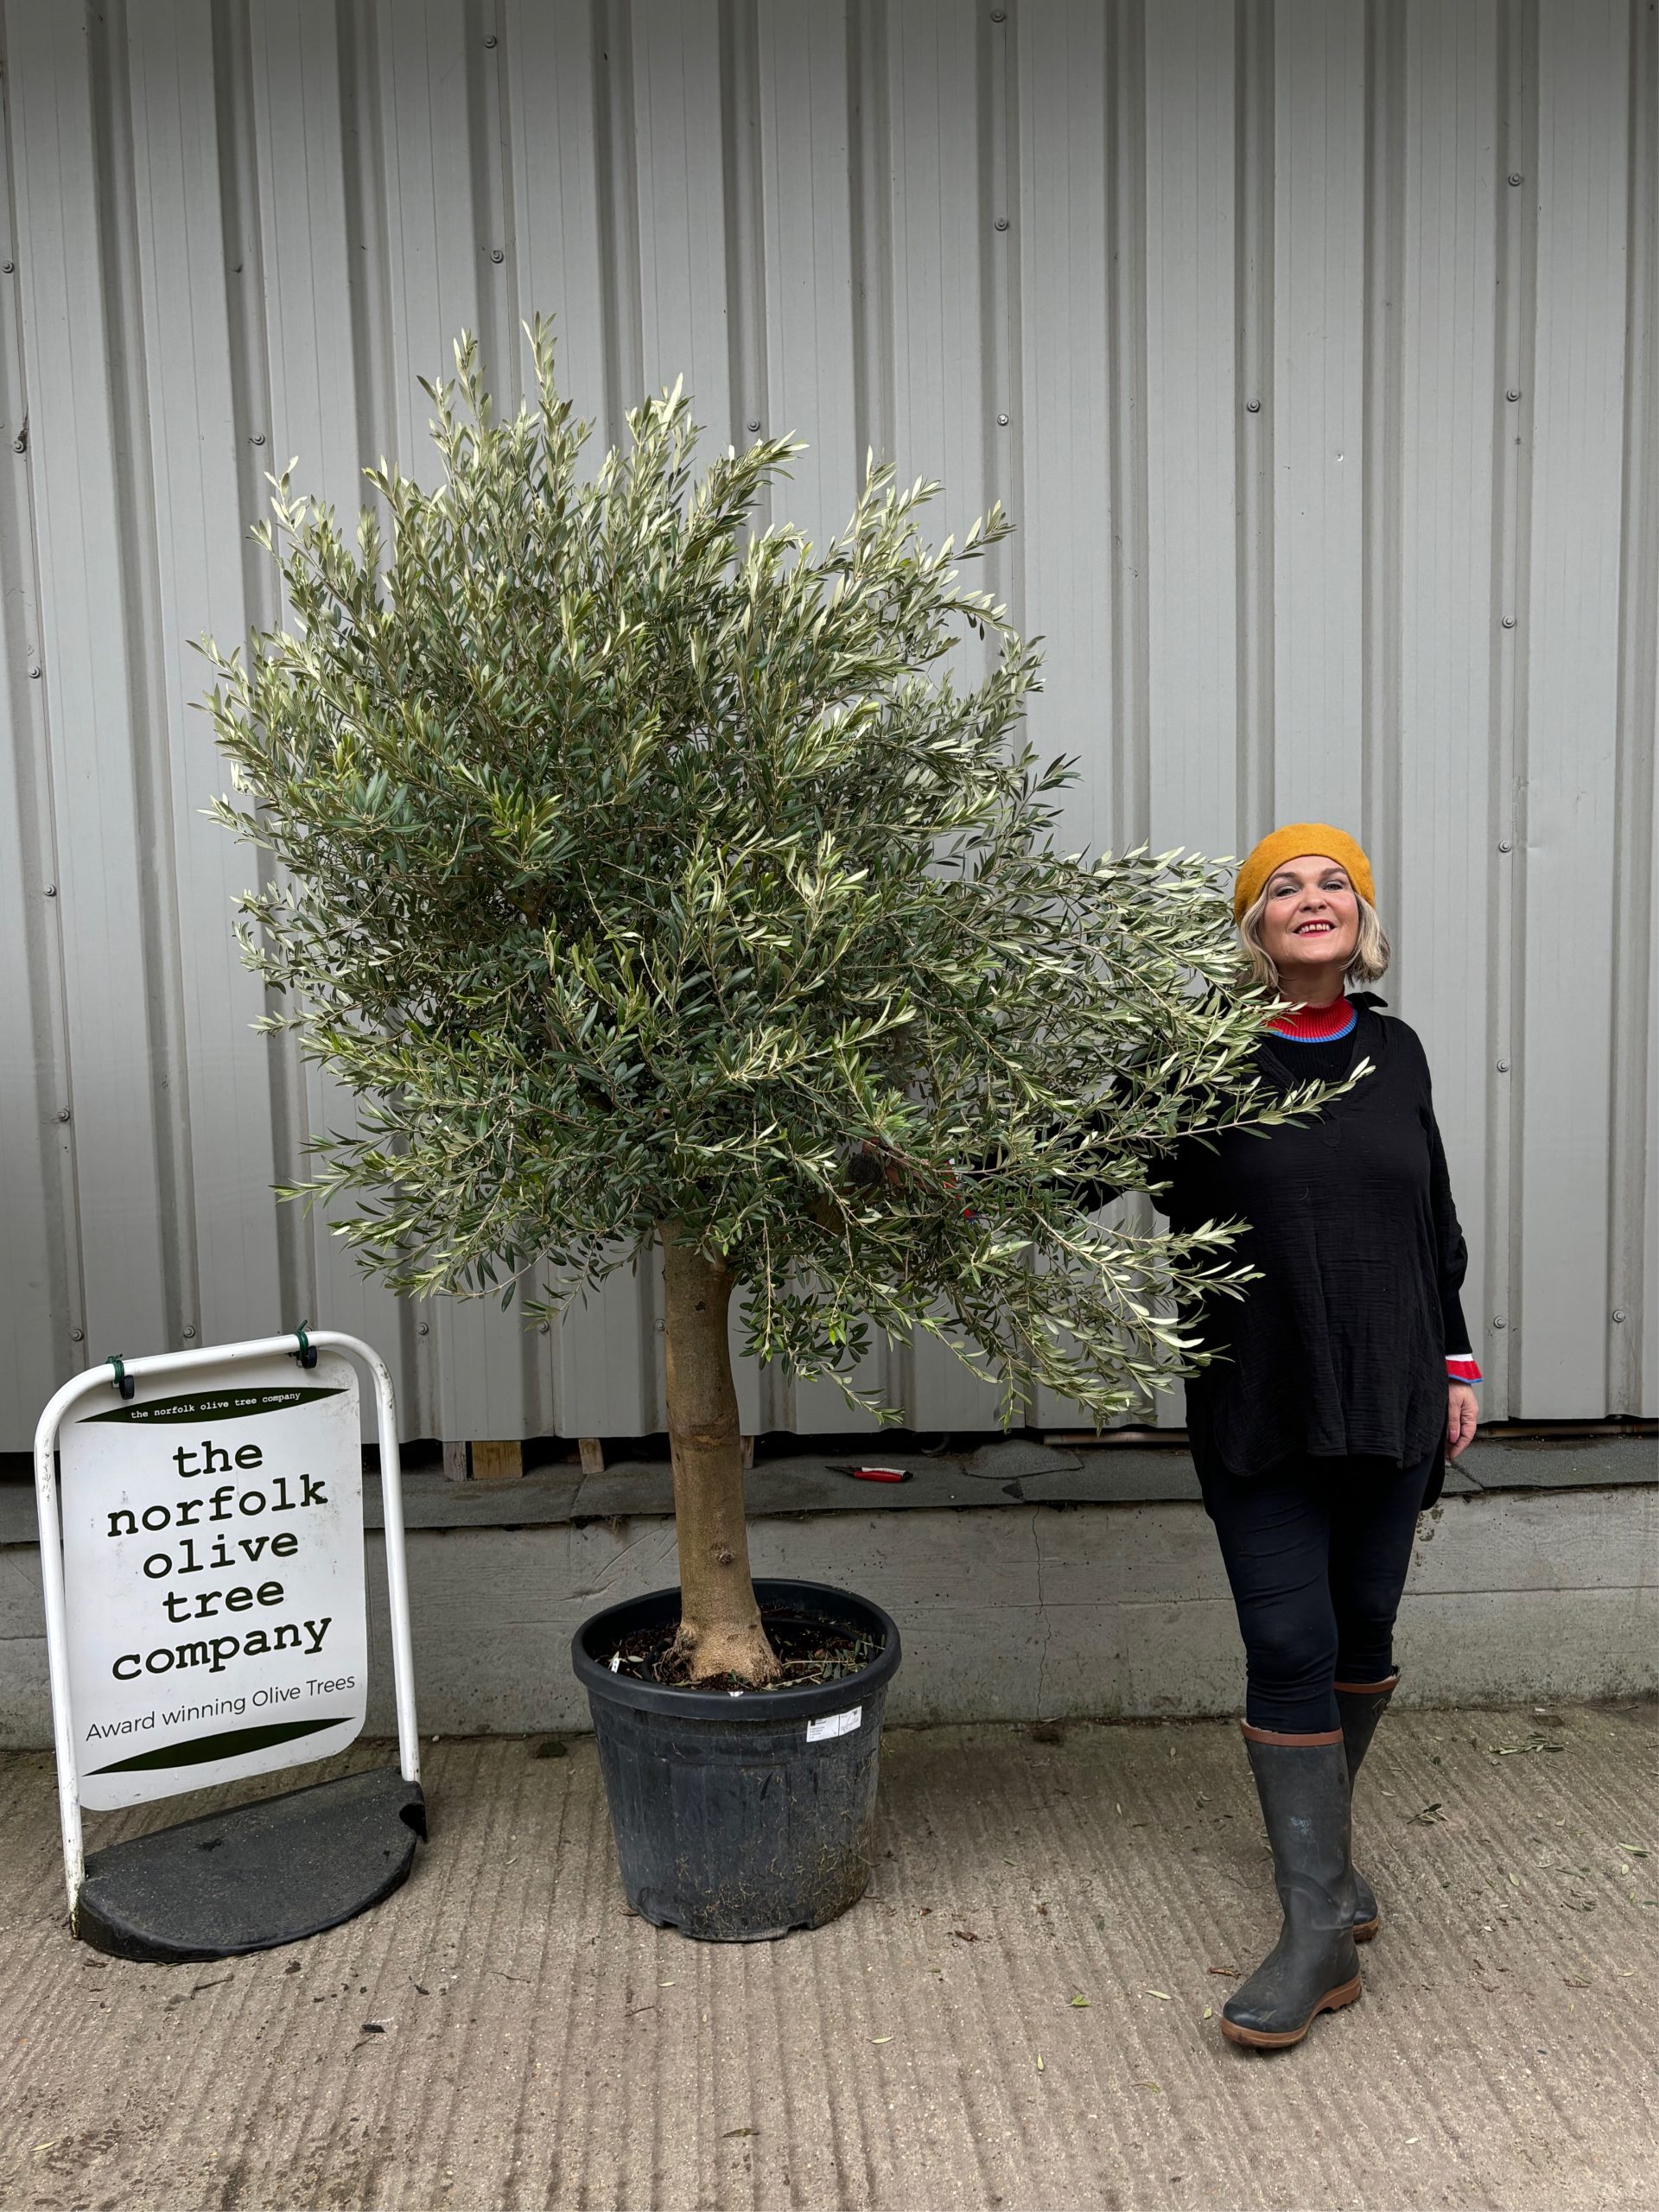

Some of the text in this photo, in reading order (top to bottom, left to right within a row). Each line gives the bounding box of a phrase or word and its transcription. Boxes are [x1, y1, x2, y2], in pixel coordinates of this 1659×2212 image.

[131, 1392, 301, 1419] the norfolk olive tree company
[173, 1441, 263, 1478] the
[108, 1474, 329, 1536] norfolk
[143, 1533, 298, 1579] olive
[162, 1581, 284, 1623] tree
[112, 1618, 332, 1680] company
[86, 1675, 355, 1741] Award winning Olive Trees
